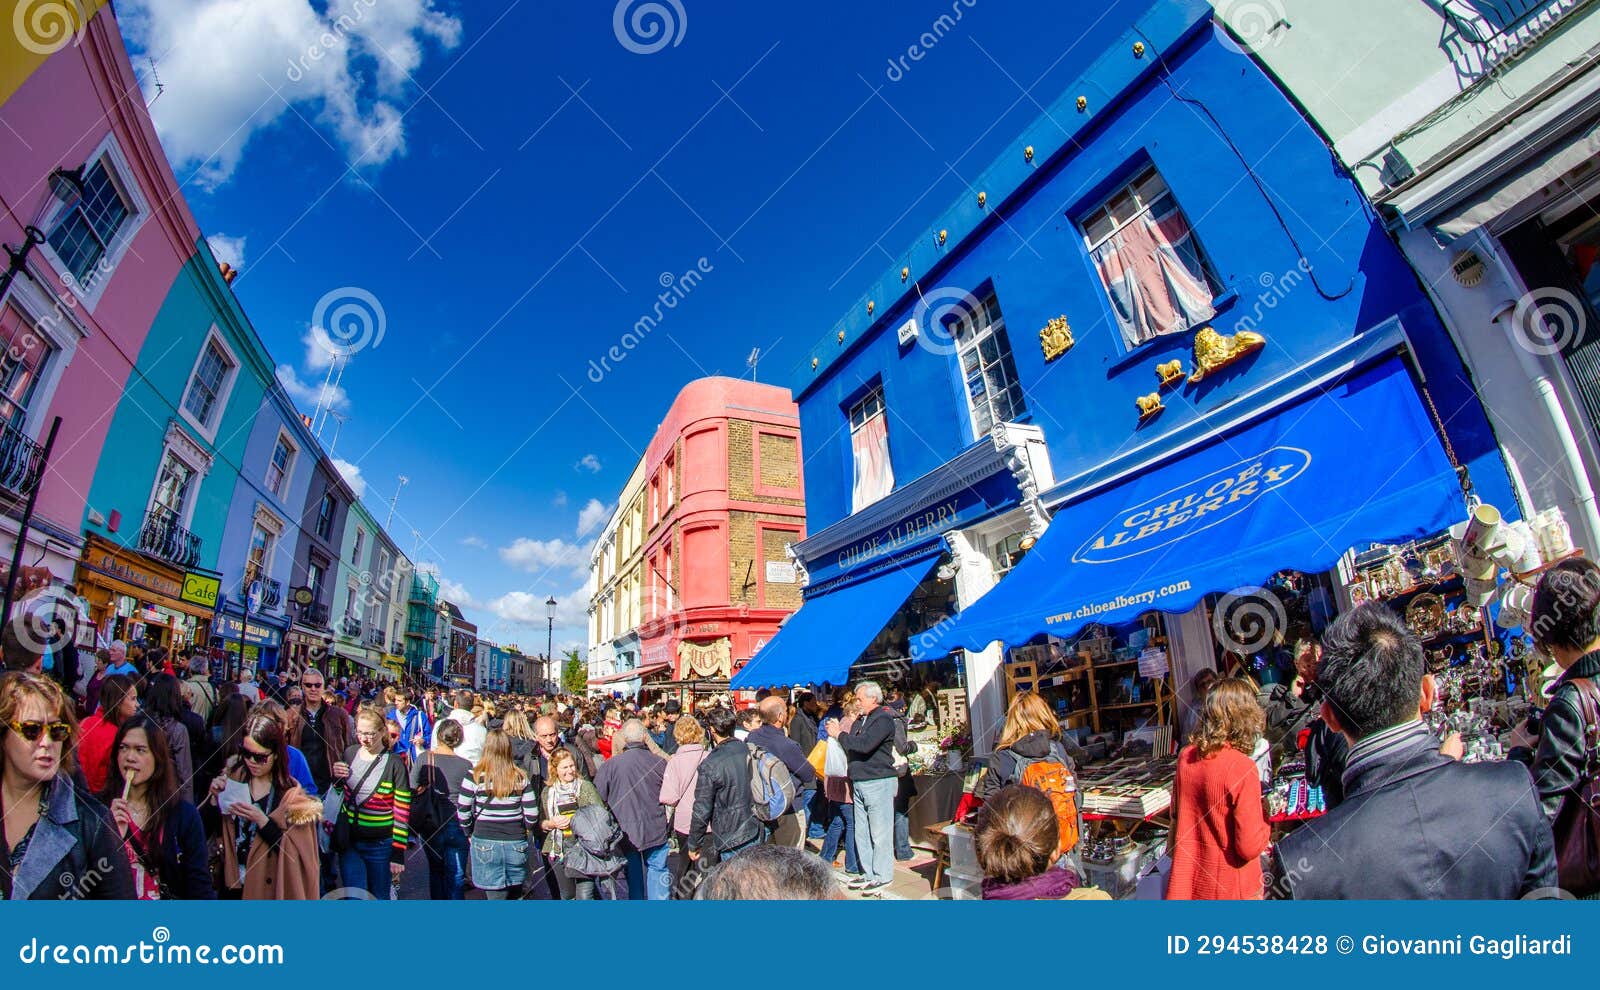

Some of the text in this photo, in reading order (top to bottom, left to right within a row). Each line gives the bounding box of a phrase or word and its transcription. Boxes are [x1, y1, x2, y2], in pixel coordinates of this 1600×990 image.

[1091, 463, 1295, 550] ALBERRY
[1123, 462, 1263, 528] CHLOE
[838, 499, 960, 569] CHLOE ALBERRY
[184, 578, 216, 601] Cafe
[1045, 579, 1192, 625] www.chloealberry.com
